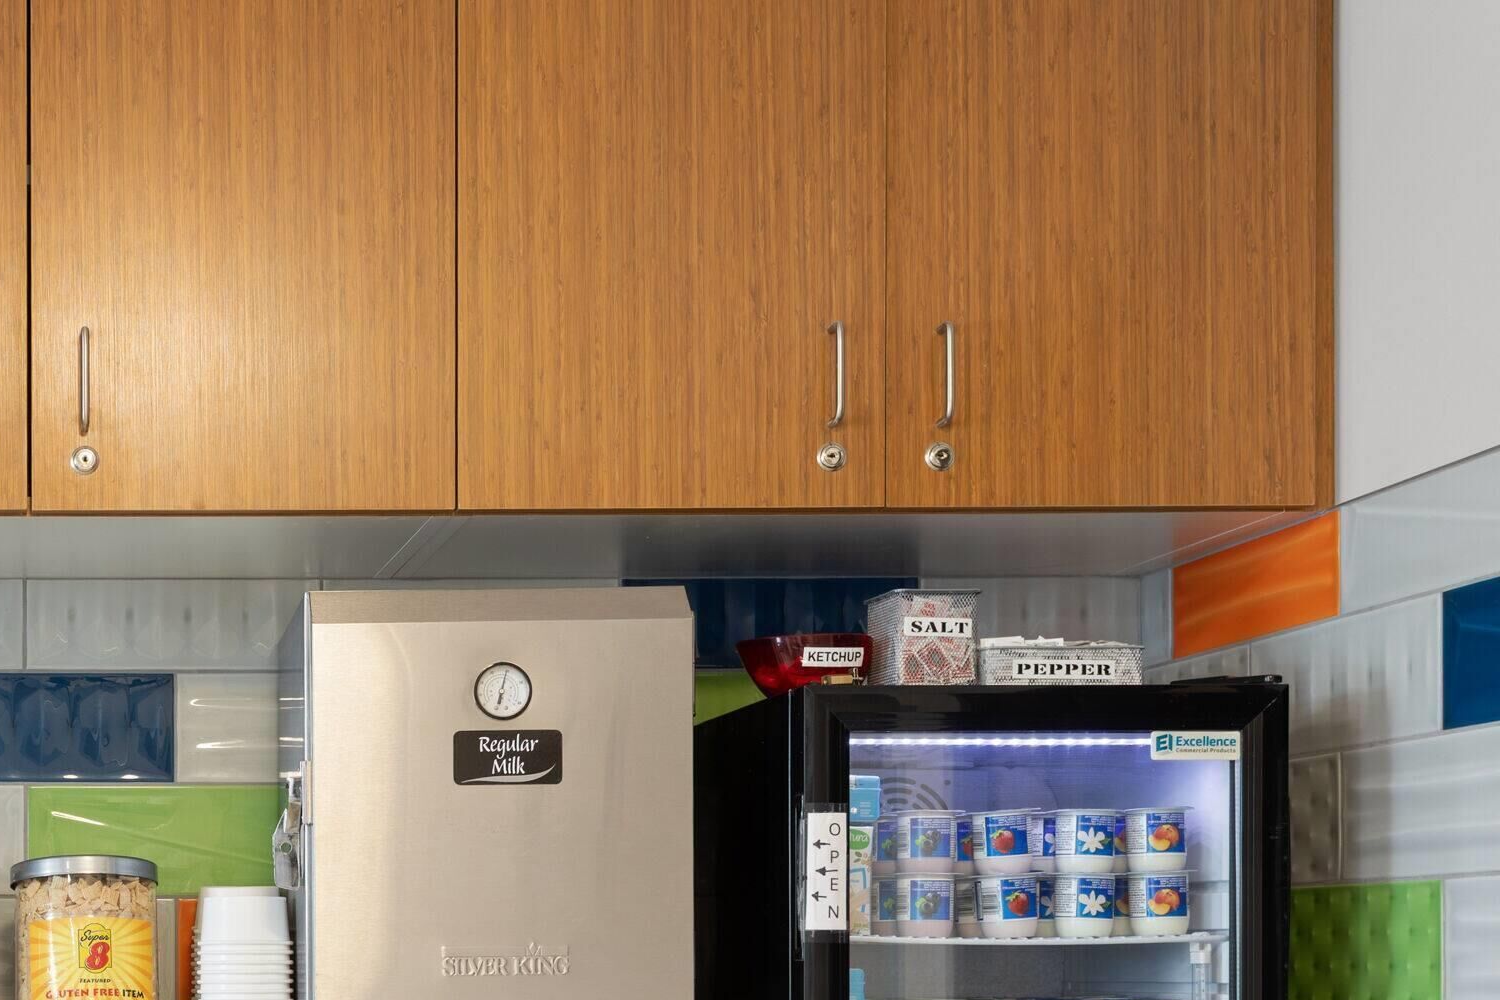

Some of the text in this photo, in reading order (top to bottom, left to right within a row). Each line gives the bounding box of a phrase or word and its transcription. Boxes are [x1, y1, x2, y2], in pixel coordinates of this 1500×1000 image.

[911, 621, 969, 634] SALT
[807, 651, 862, 662] KETCHUP
[1017, 663, 1112, 676] PEPPER
[478, 733, 539, 760] Regular
[1175, 735, 1237, 747] Excellence
[491, 756, 526, 775] Milk
[828, 822, 841, 919] OPEN
[80, 929, 110, 947] Super
[85, 941, 111, 970] 8
[442, 956, 570, 976] SILVER KING
[45, 988, 144, 999] GUTEN FREE ITEM
